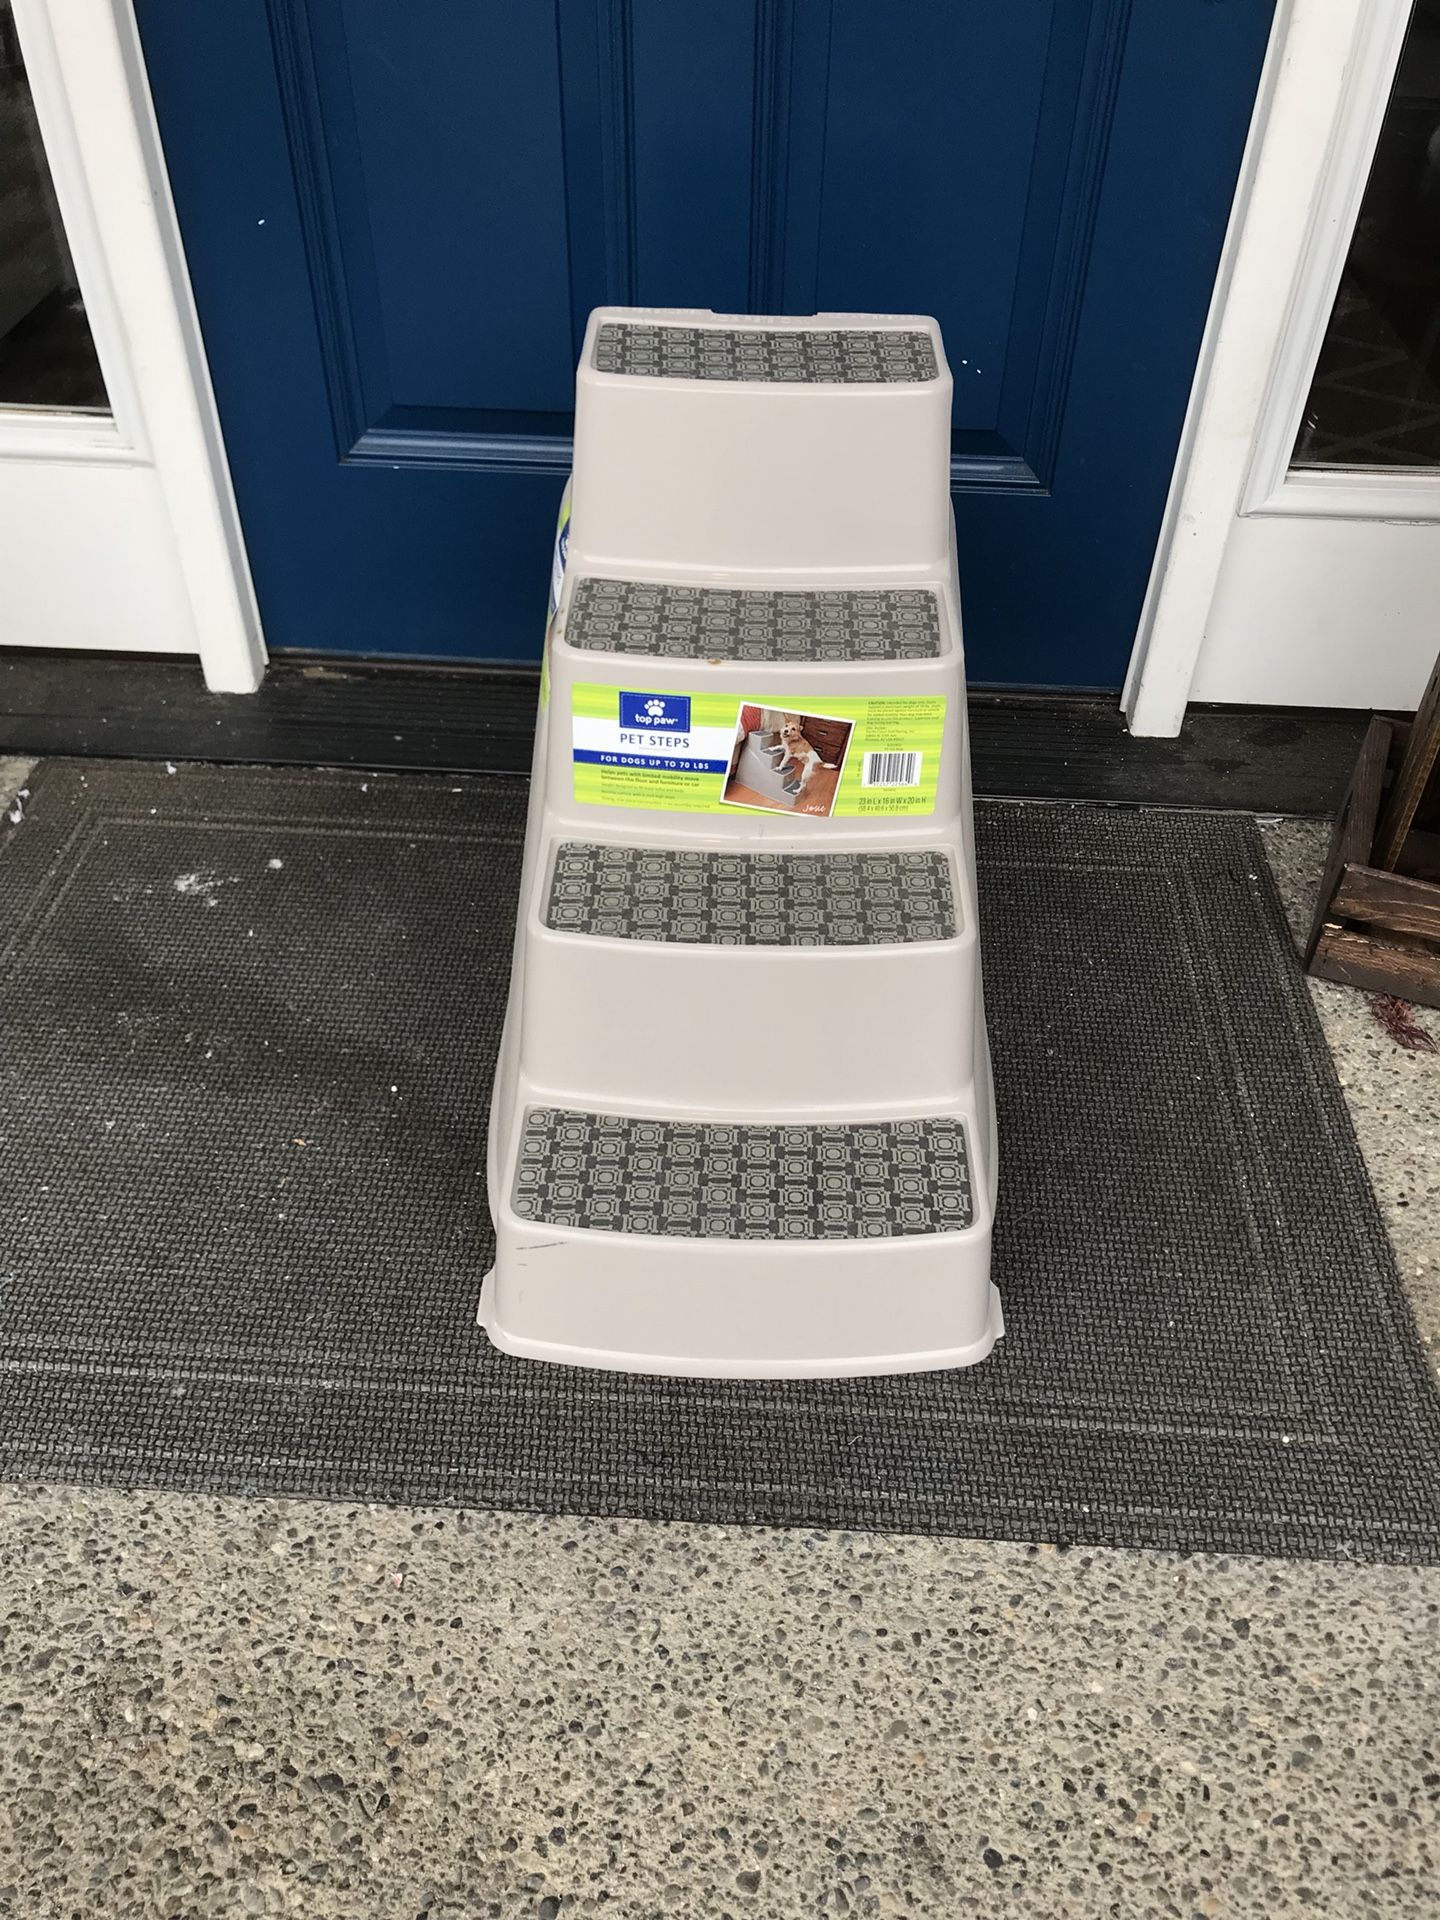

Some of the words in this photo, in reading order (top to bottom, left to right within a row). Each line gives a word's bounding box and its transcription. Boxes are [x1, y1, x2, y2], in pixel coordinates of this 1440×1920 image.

[635, 714, 651, 725] top
[654, 717, 675, 726] paw
[620, 733, 644, 744] PET
[650, 735, 690, 748] STEPS
[600, 754, 618, 763] FOR
[621, 757, 646, 766] DOGS
[649, 759, 661, 767] UP
[664, 760, 676, 768] TO
[679, 761, 690, 769] 70
[693, 762, 709, 770] LBS
[662, 773, 683, 781] mobility
[802, 803, 826, 812] Josie
